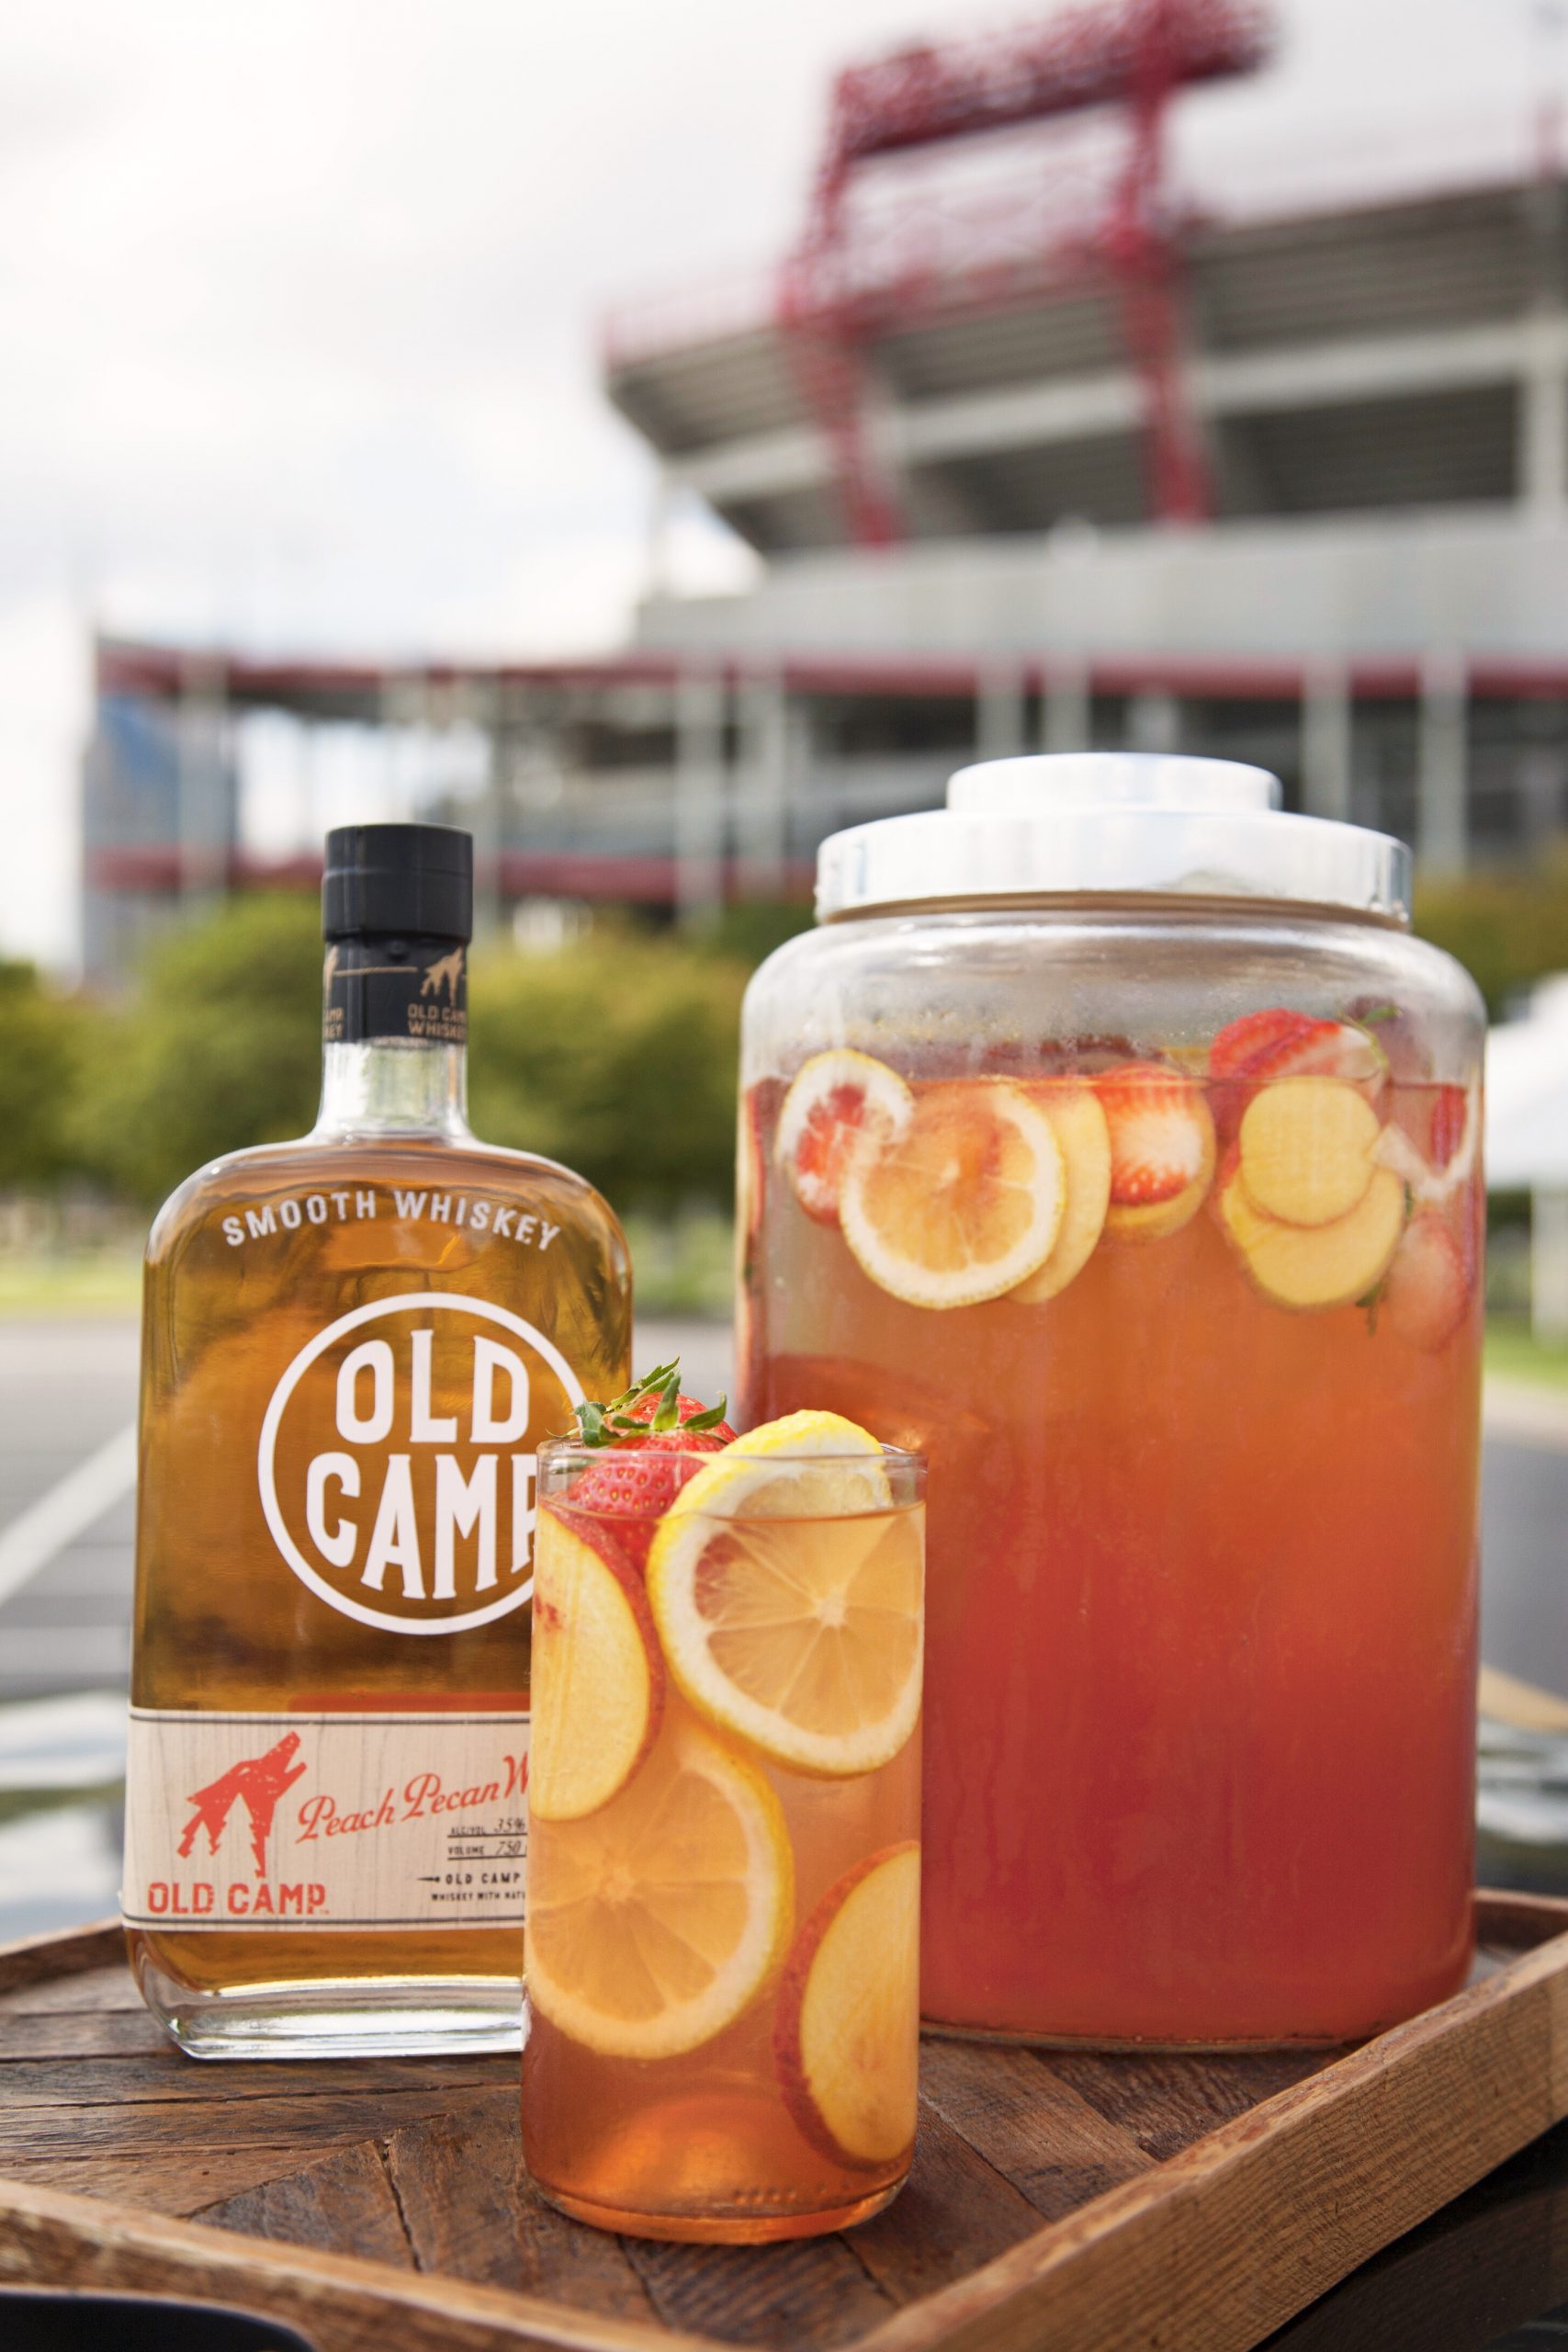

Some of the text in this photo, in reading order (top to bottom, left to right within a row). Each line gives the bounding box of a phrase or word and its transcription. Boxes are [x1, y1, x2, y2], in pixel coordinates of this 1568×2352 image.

[408, 1002, 439, 1020] OLD
[222, 1190, 560, 1250] SMOOTH WHISKEY
[336, 1329, 529, 1443] OLD
[306, 1453, 537, 1600] CAMP
[295, 1788, 395, 1845] Peach
[400, 1772, 500, 1822] Pecan
[448, 1846, 484, 1856] VOLUME
[496, 1840, 523, 1856] 750
[446, 1872, 521, 1885] OLD CAMP
[148, 1882, 326, 1915] OLD CAMP
[432, 1893, 473, 1902] WHISKEY
[477, 1892, 501, 1900] WITH
